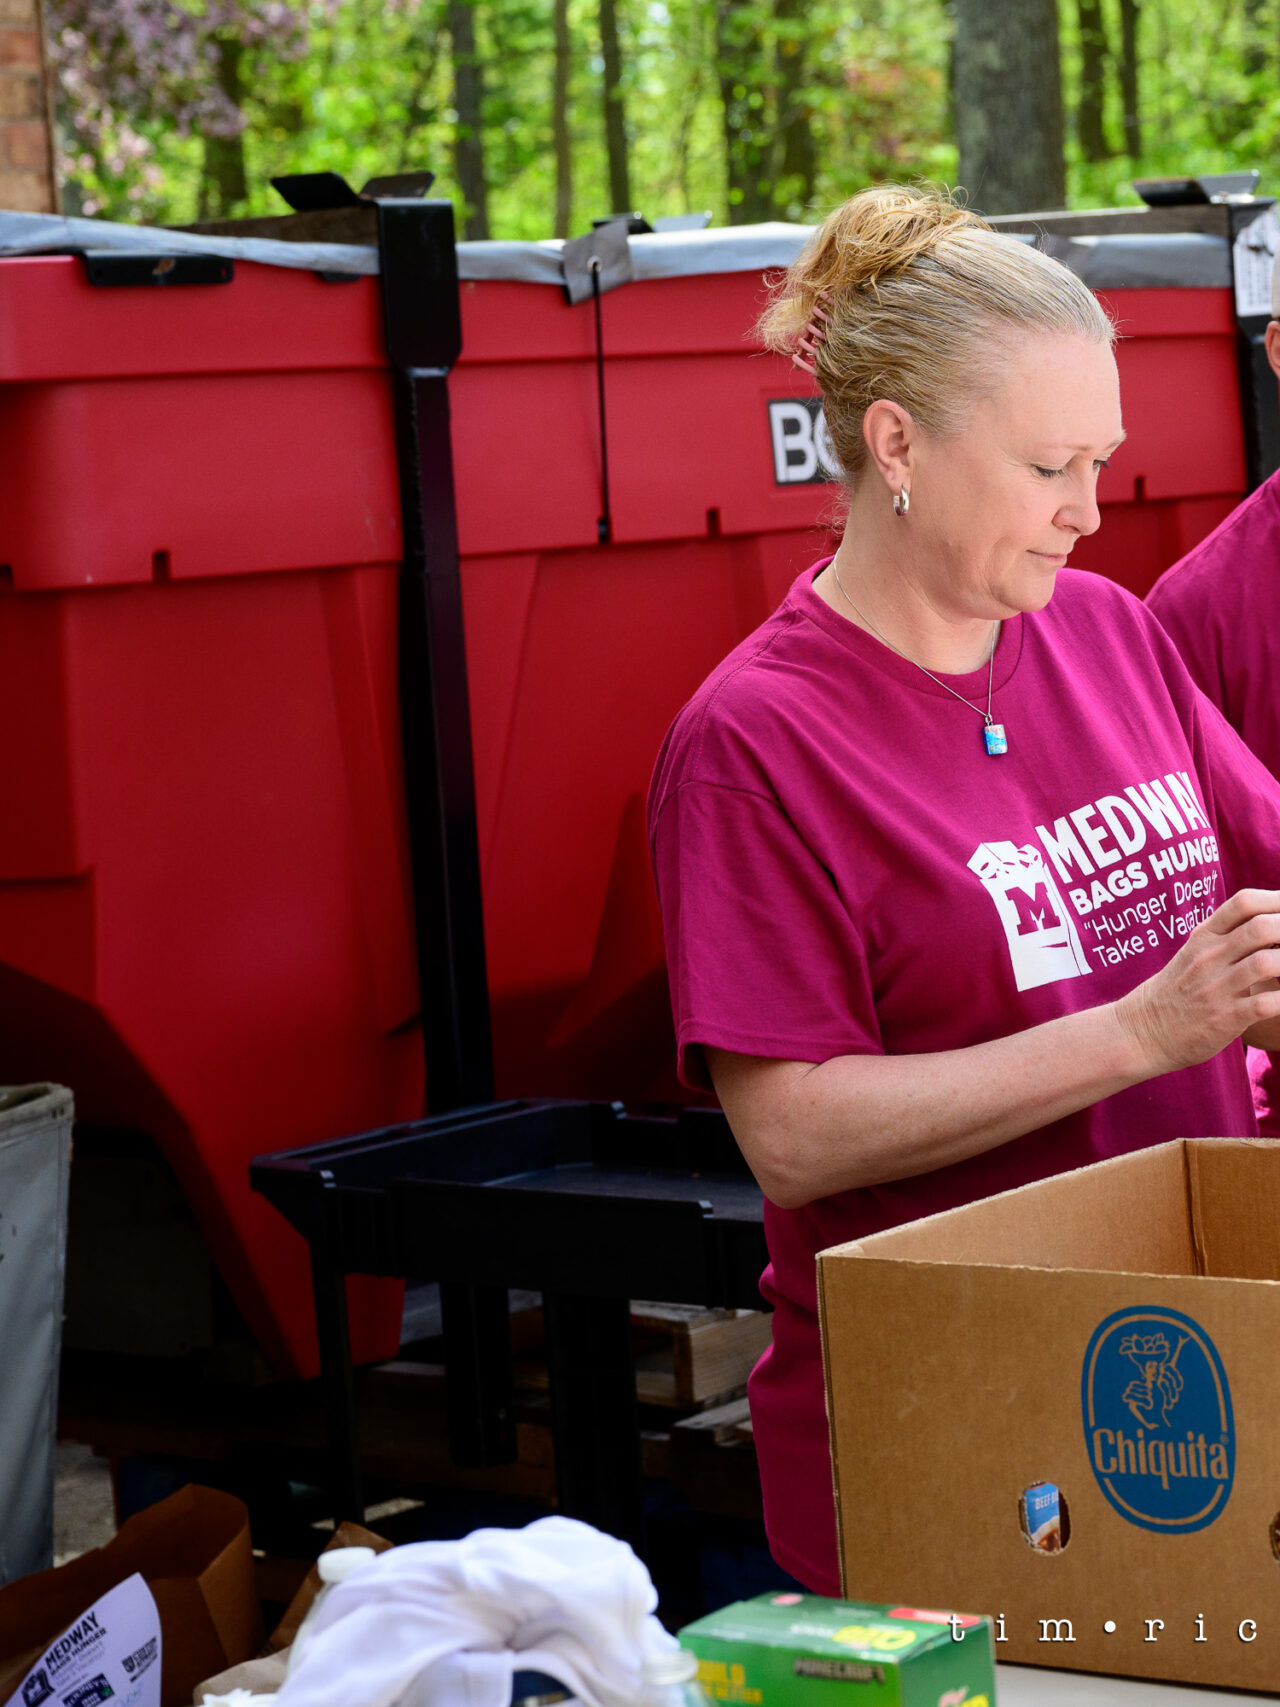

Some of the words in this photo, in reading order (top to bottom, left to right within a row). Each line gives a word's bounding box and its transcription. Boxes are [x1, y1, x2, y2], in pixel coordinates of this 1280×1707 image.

[1068, 861, 1149, 915] BAGS
[1148, 835, 1220, 881] HUNGE
[1004, 882, 1061, 936] M
[1092, 935, 1145, 968] Take
[1146, 929, 1160, 948] a
[1093, 1427, 1230, 1490] Chiquita
[45, 1611, 99, 1670] MEDWAY
[71, 1627, 107, 1657] HUNGER
